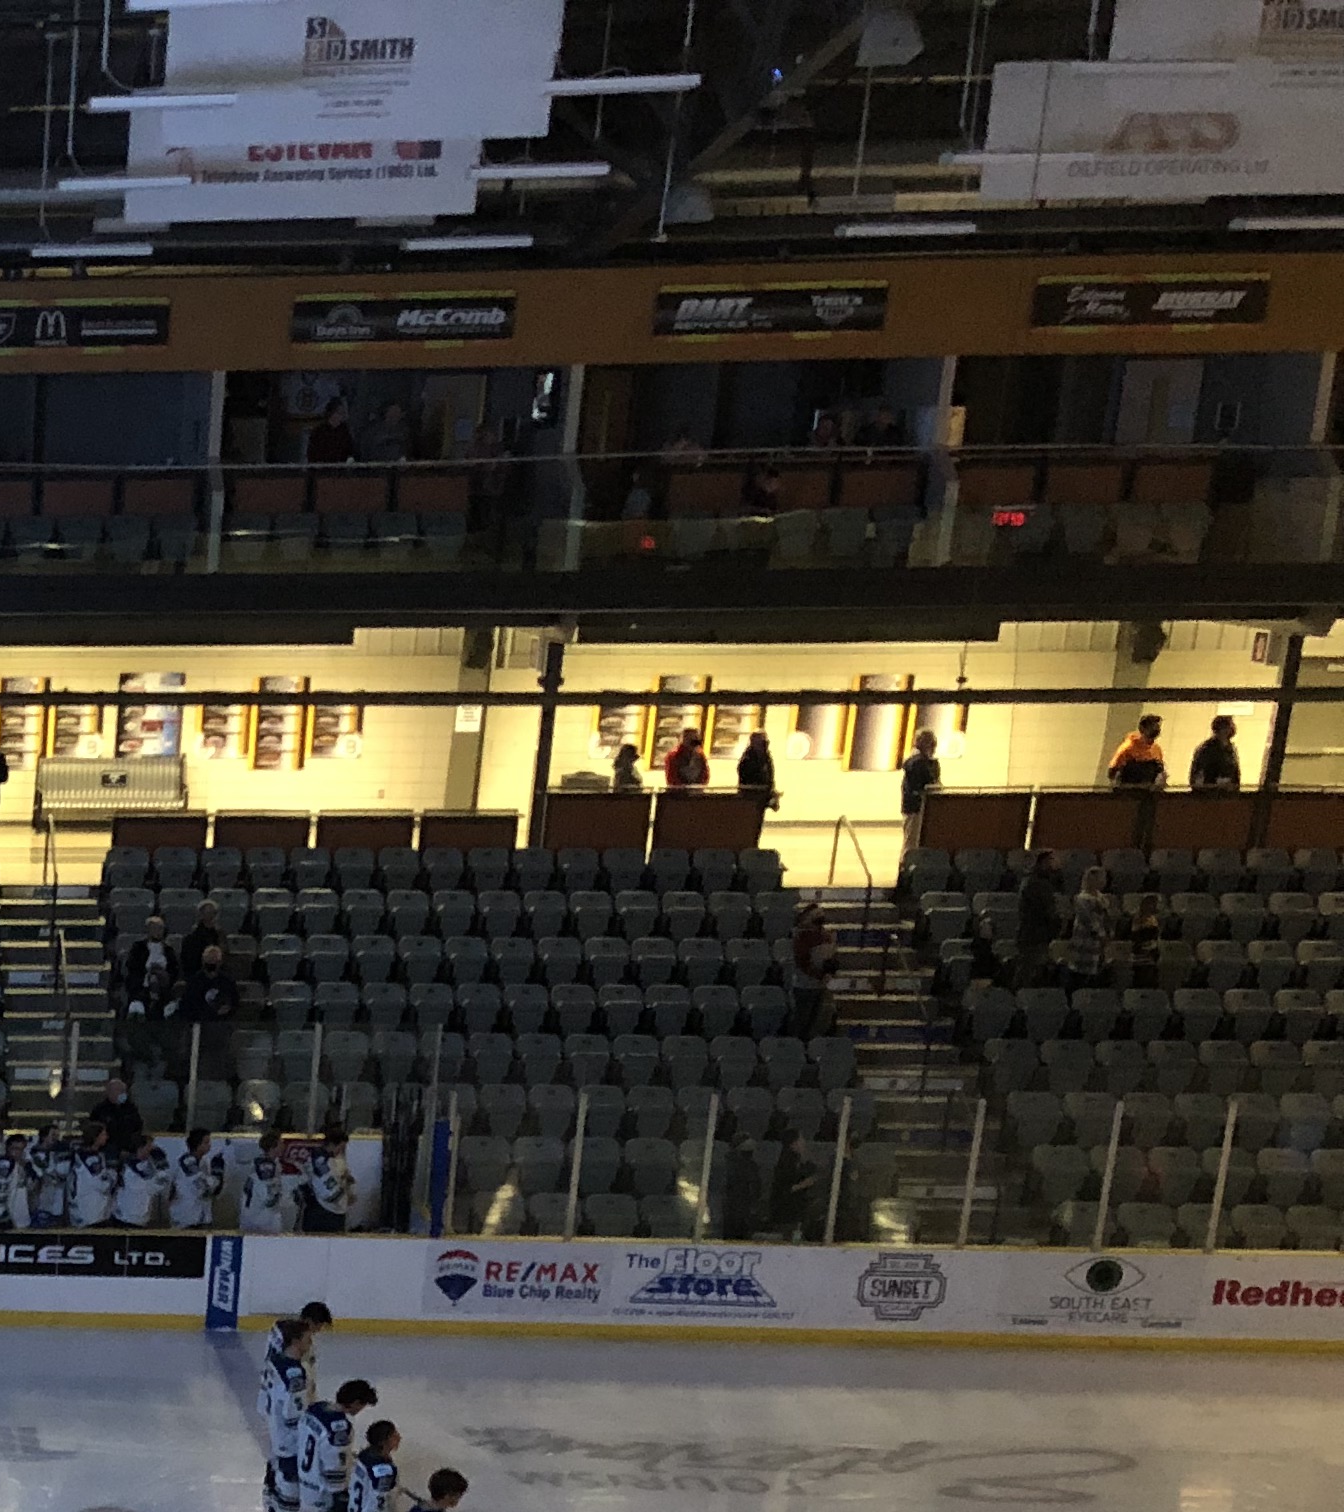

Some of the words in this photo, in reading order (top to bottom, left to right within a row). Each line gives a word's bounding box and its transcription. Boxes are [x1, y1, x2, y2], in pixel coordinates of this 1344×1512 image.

[349, 38, 415, 60] SMITH
[397, 307, 507, 327] McComb
[113, 1250, 171, 1267] LTD.
[626, 1253, 662, 1268] The
[665, 1248, 762, 1276] Floor
[485, 1261, 601, 1284] RE/MAX
[482, 1284, 515, 1299] Blue
[518, 1284, 550, 1303] Chip
[555, 1286, 602, 1303] Realty
[870, 1278, 932, 1299] SUNSET
[1212, 1279, 1344, 1307] Redhe
[1049, 1295, 1105, 1310] SOUTH
[1111, 1297, 1152, 1311] EAST
[1068, 1312, 1129, 1324] EYECARE
